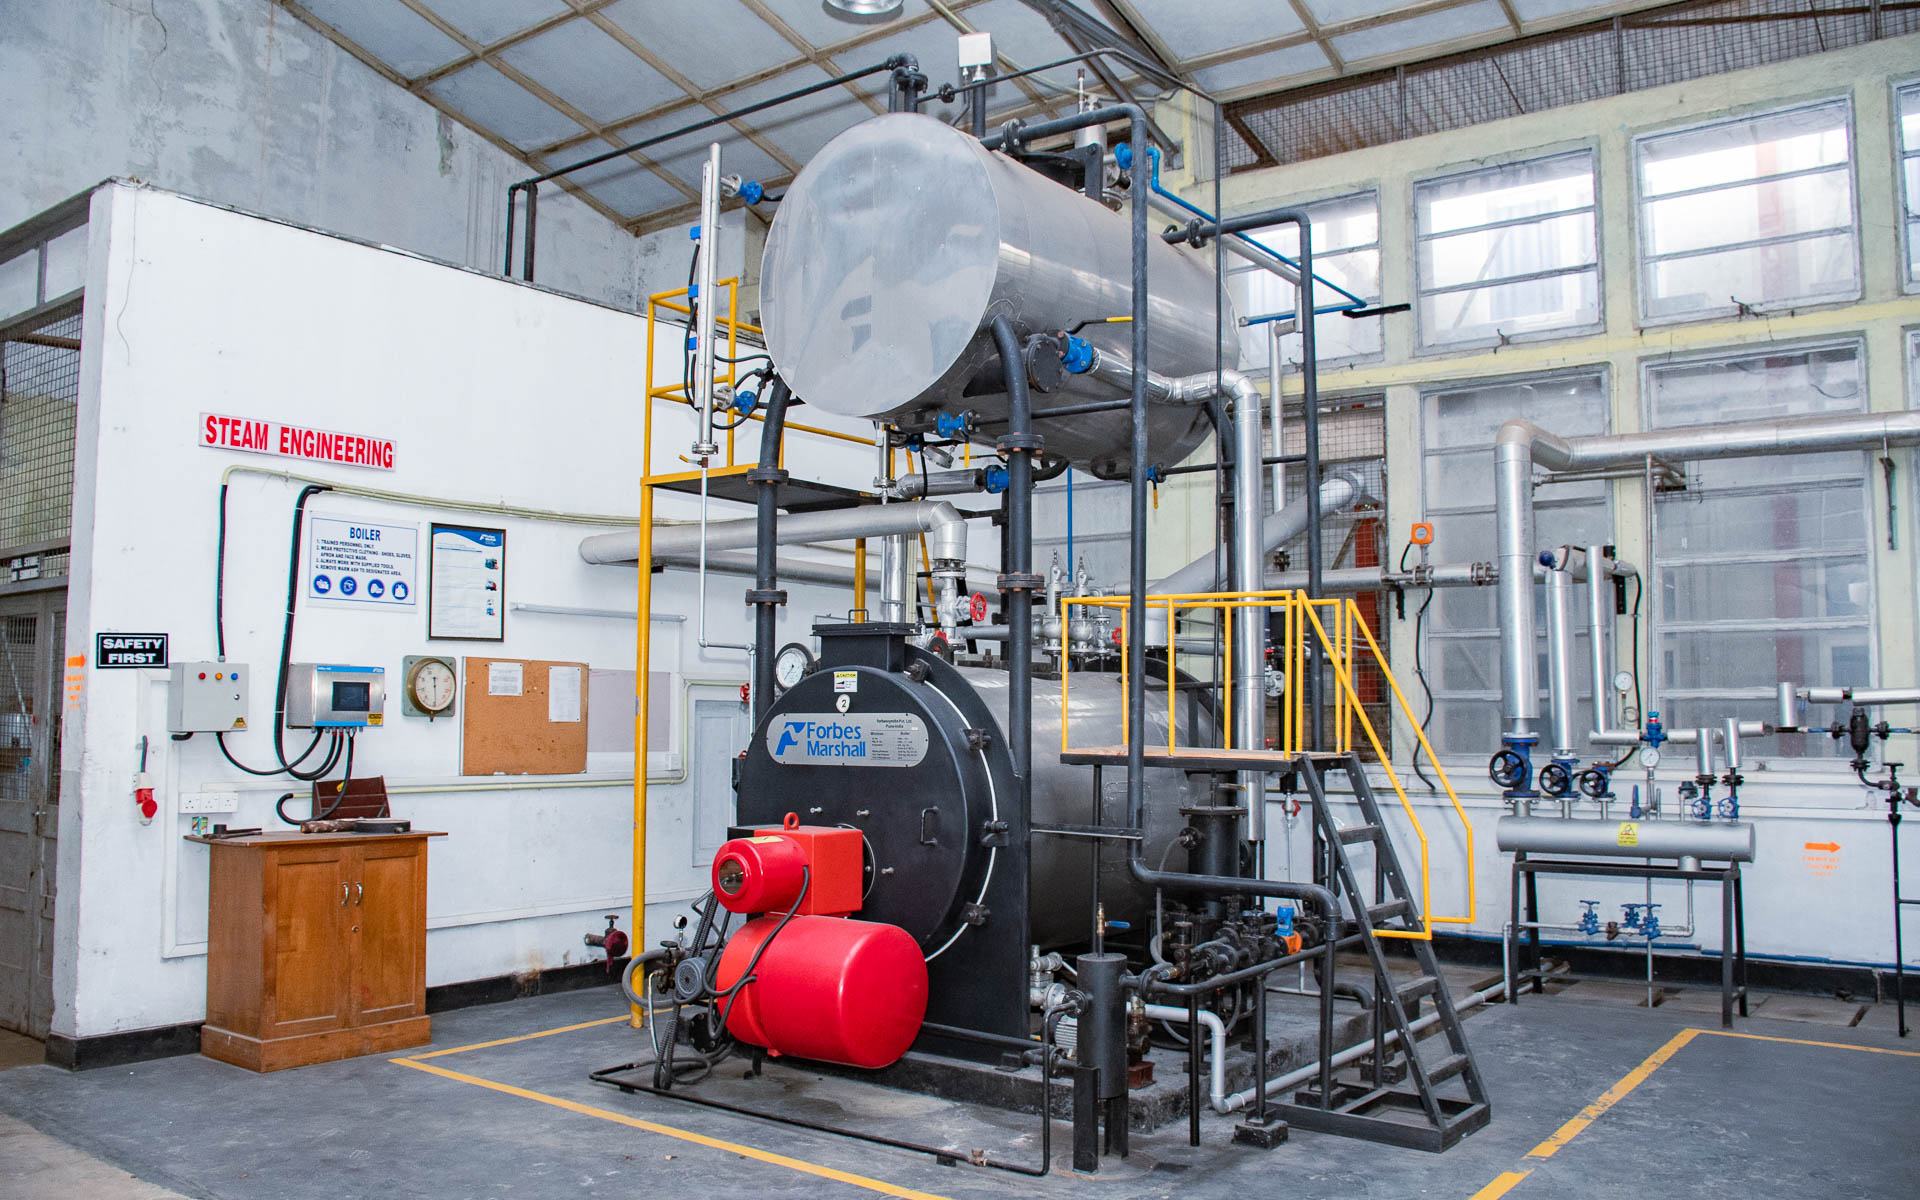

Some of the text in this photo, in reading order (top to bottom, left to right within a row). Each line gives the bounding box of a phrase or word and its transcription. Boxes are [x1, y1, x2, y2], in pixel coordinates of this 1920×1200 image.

[205, 415, 393, 468] STEAM ENGINEERING
[349, 527, 381, 541] BOILER
[339, 540, 363, 548] PERSONNEL
[103, 638, 163, 649] SAFETY
[108, 653, 156, 664] FIRST
[841, 699, 847, 708] 2
[807, 721, 862, 739] Forbes
[807, 741, 866, 757] Marshall
